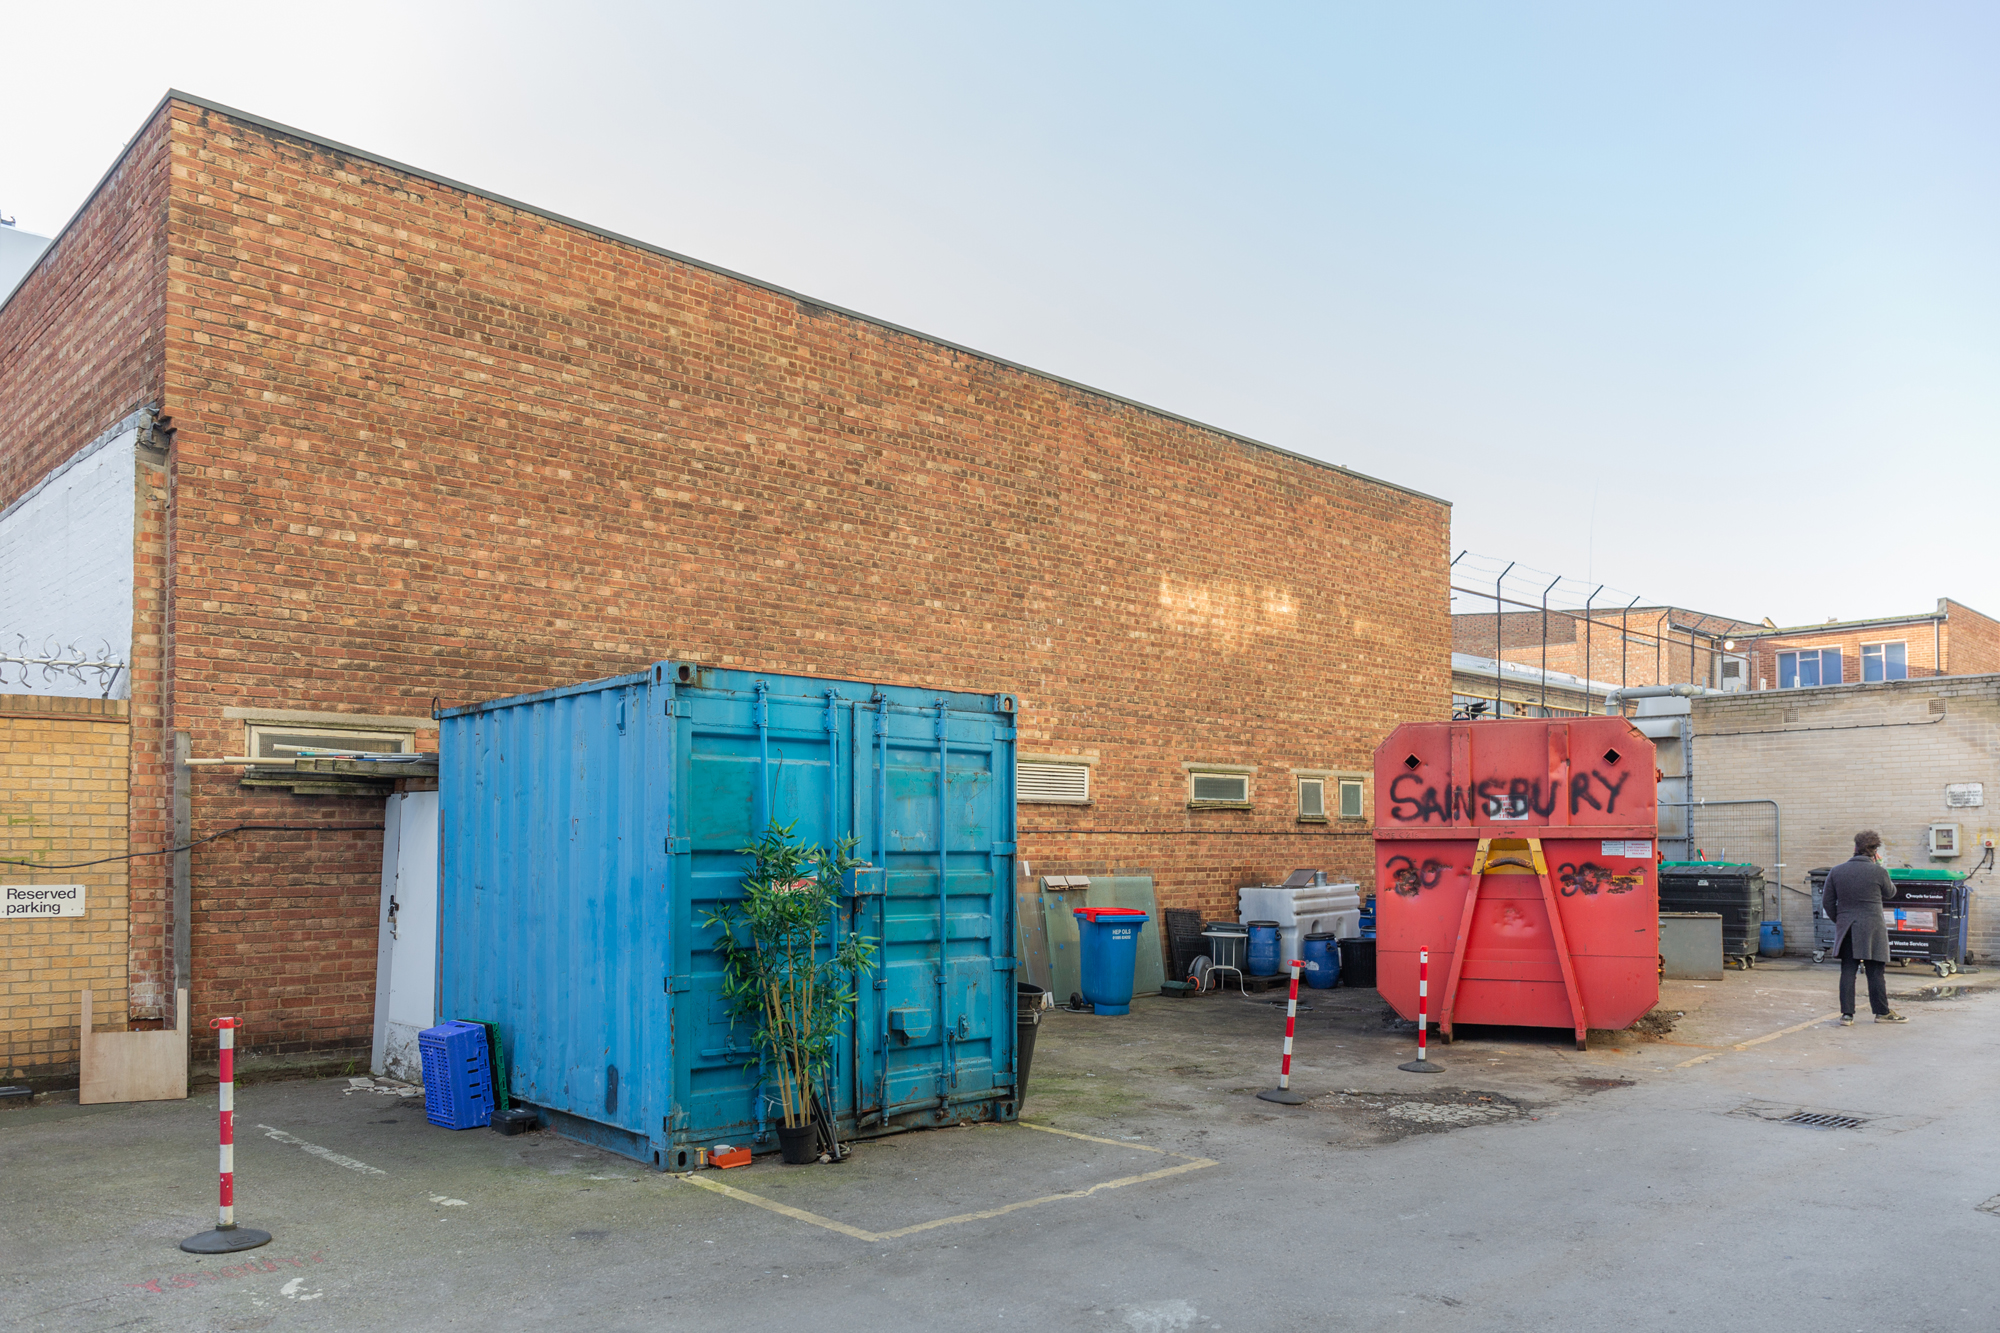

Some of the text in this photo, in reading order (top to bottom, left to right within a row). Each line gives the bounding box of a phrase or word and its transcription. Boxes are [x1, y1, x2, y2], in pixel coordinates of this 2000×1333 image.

[1390, 770, 1629, 822] SAINSBURY
[7, 888, 76, 899] Reserved
[7, 902, 61, 916] parking
